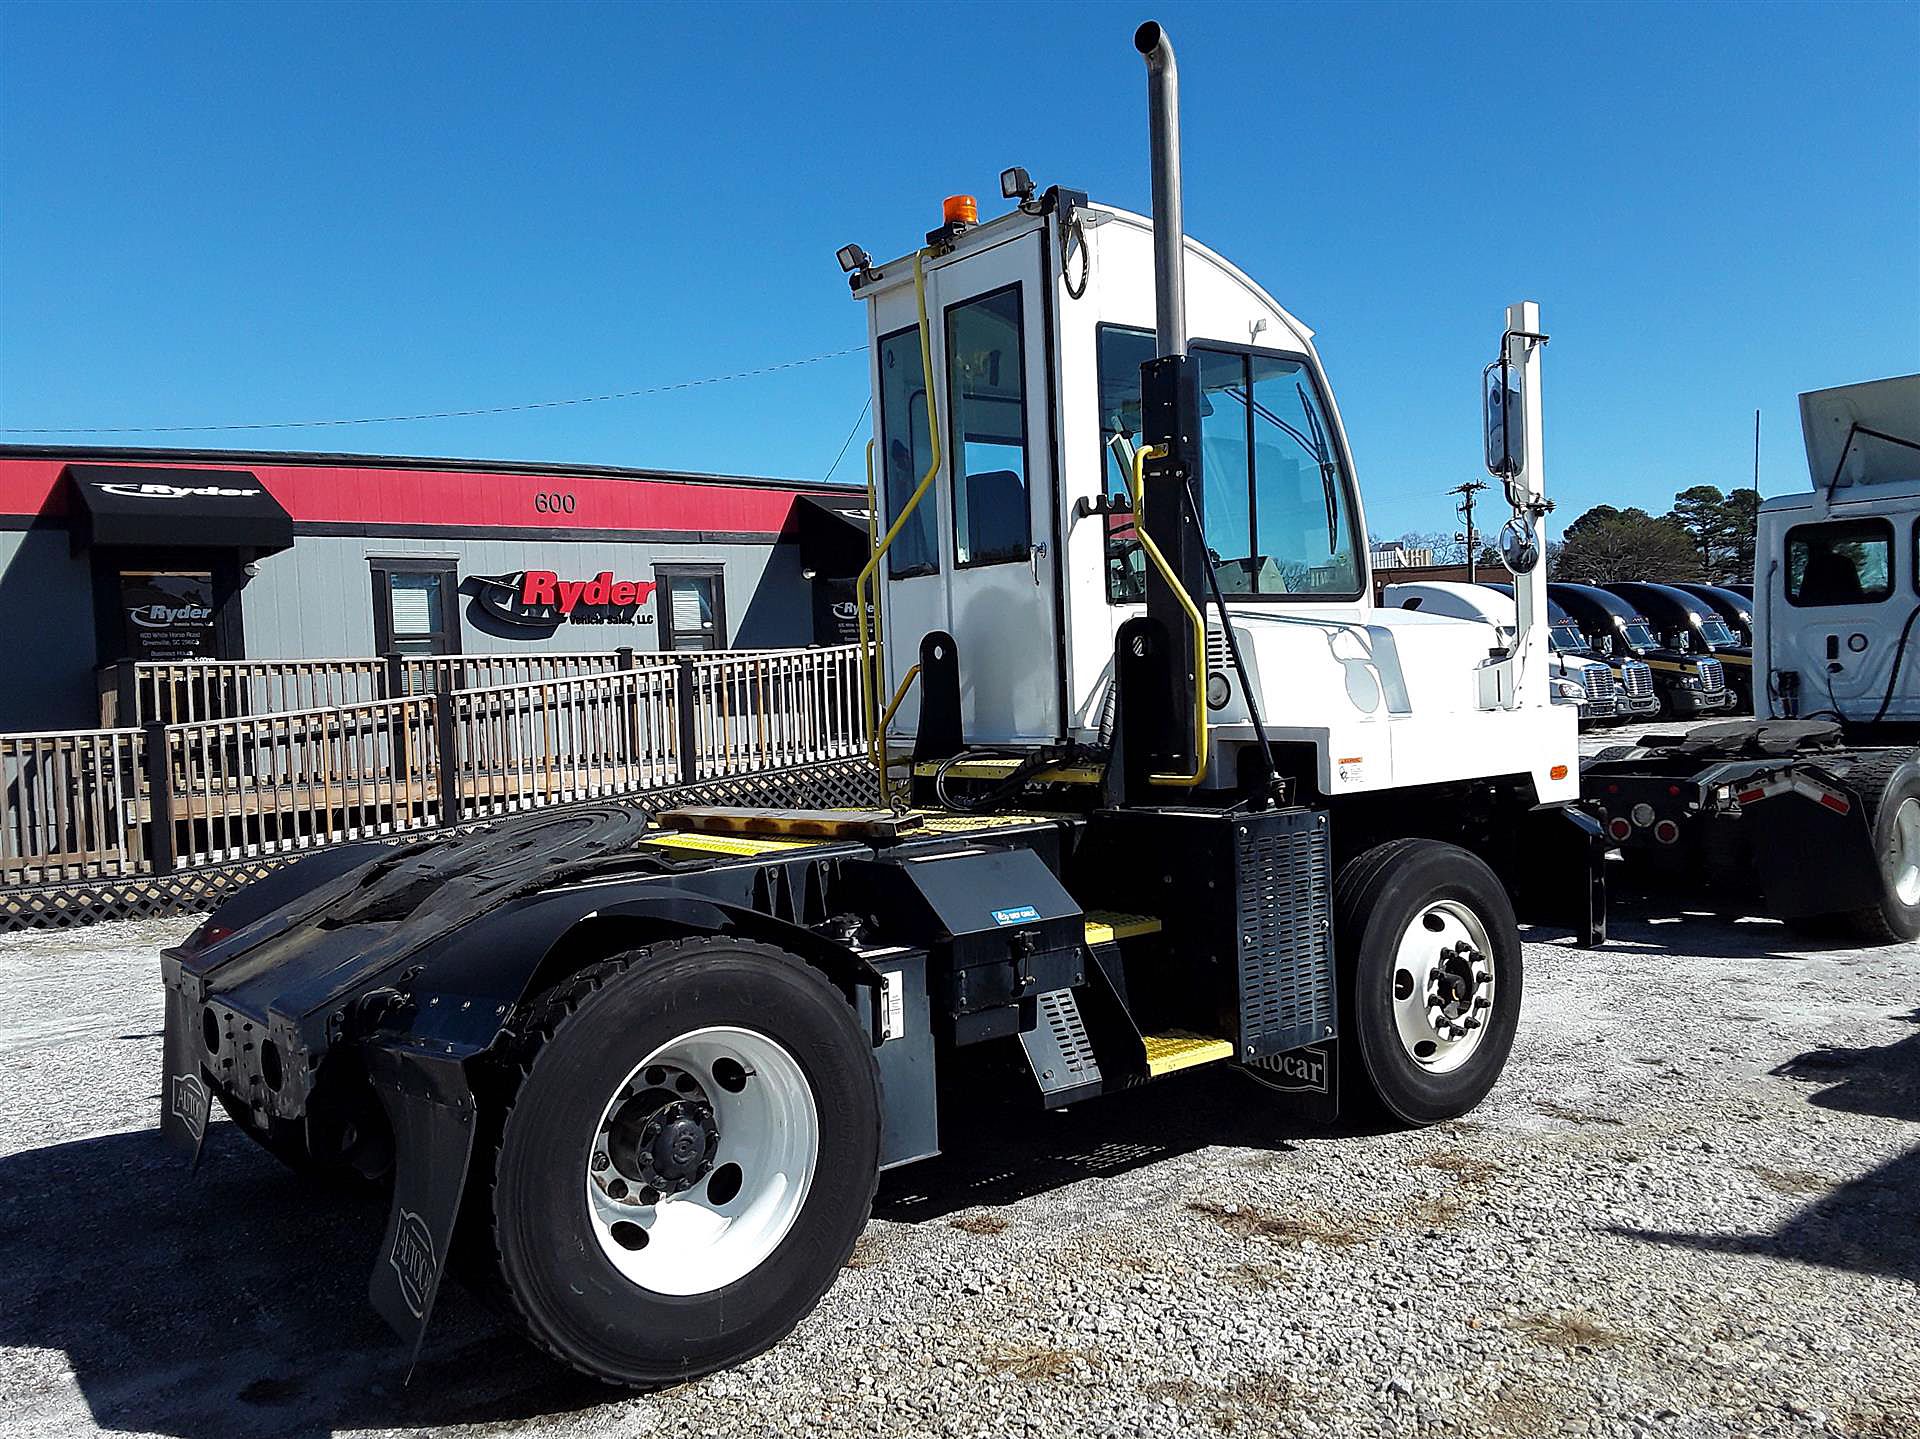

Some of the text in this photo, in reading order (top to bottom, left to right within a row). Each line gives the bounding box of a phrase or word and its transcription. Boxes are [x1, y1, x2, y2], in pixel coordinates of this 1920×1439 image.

[140, 484, 261, 497] Ryder
[535, 492, 576, 514] 600
[522, 570, 657, 614] Ryder
[150, 604, 212, 623] Ryder
[637, 614, 654, 625] LLC
